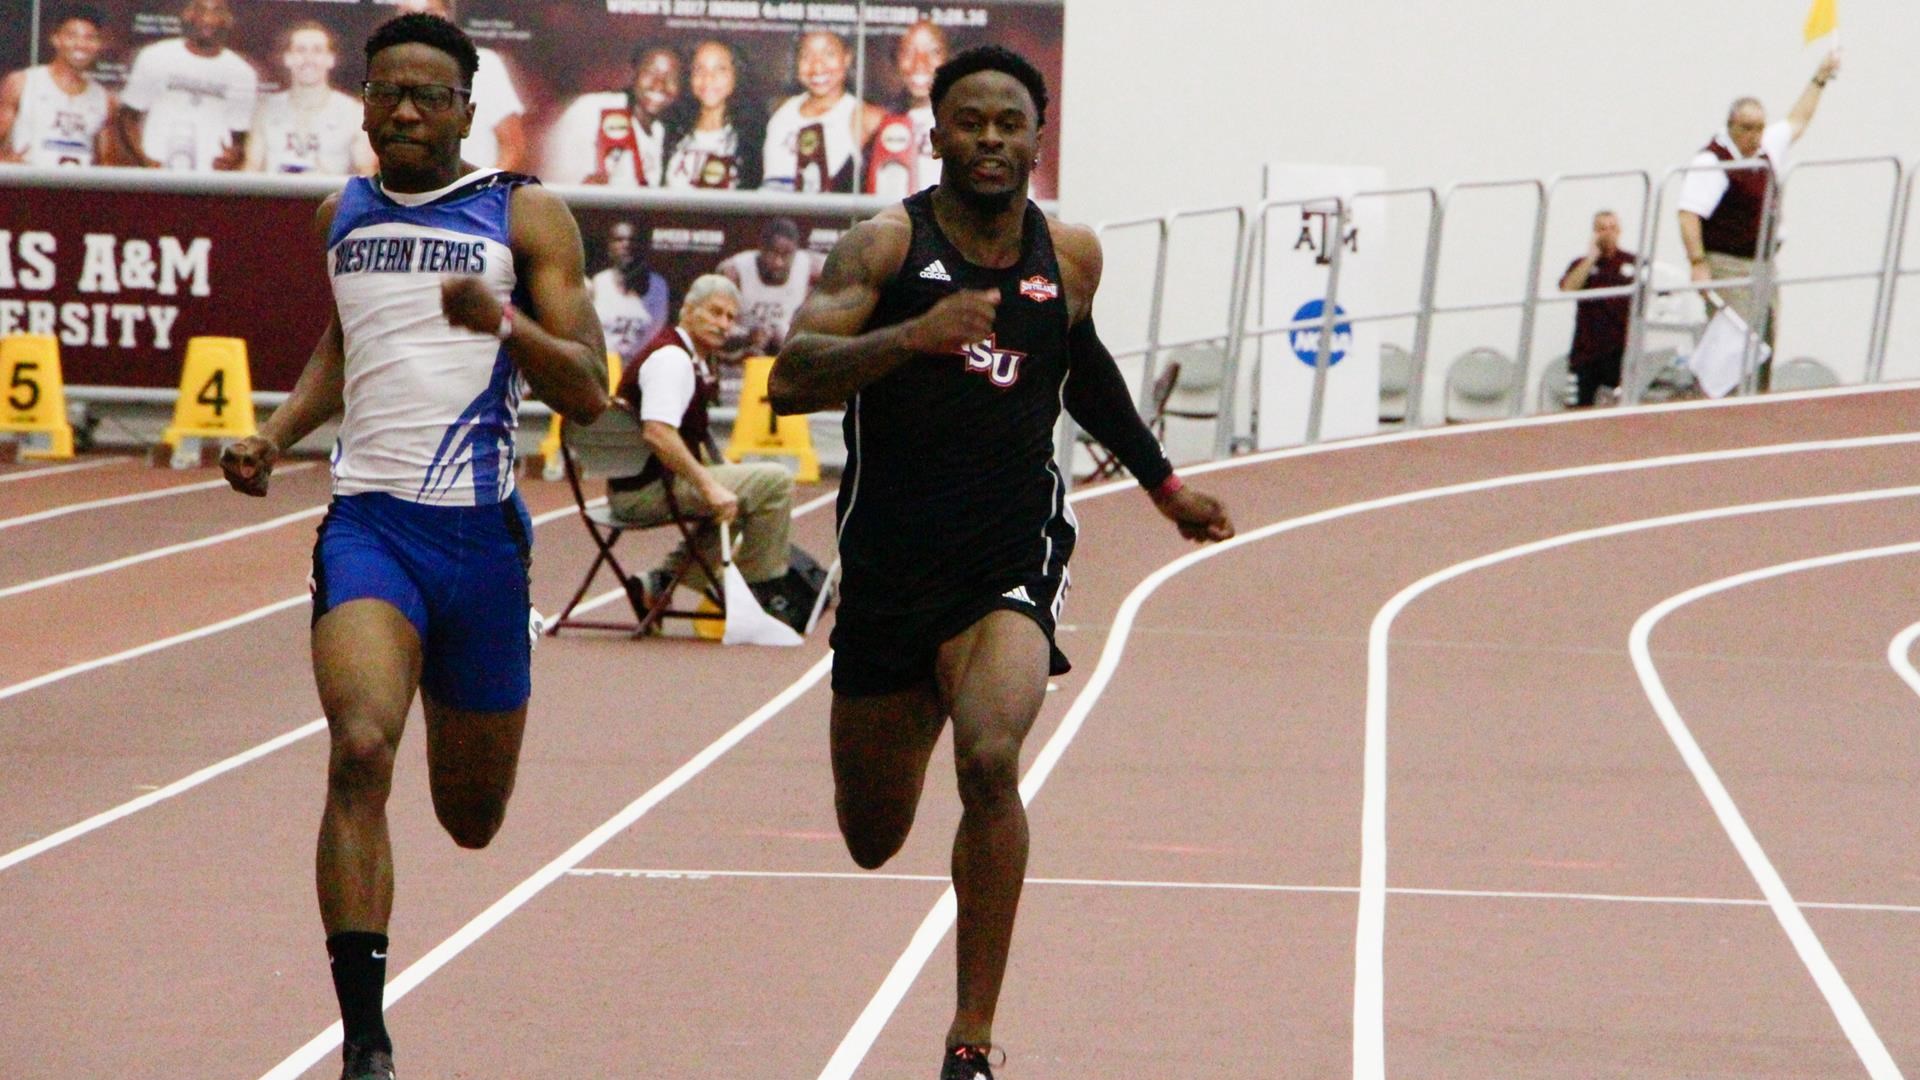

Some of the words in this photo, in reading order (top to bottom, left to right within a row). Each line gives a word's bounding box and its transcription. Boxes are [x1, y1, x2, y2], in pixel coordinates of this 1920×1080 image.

[78, 233, 212, 296] A&M
[334, 236, 417, 276] WESTERN
[417, 236, 488, 275] TEXAS
[919, 270, 951, 282] adidas
[9, 361, 39, 411] 5
[196, 368, 229, 417] 4
